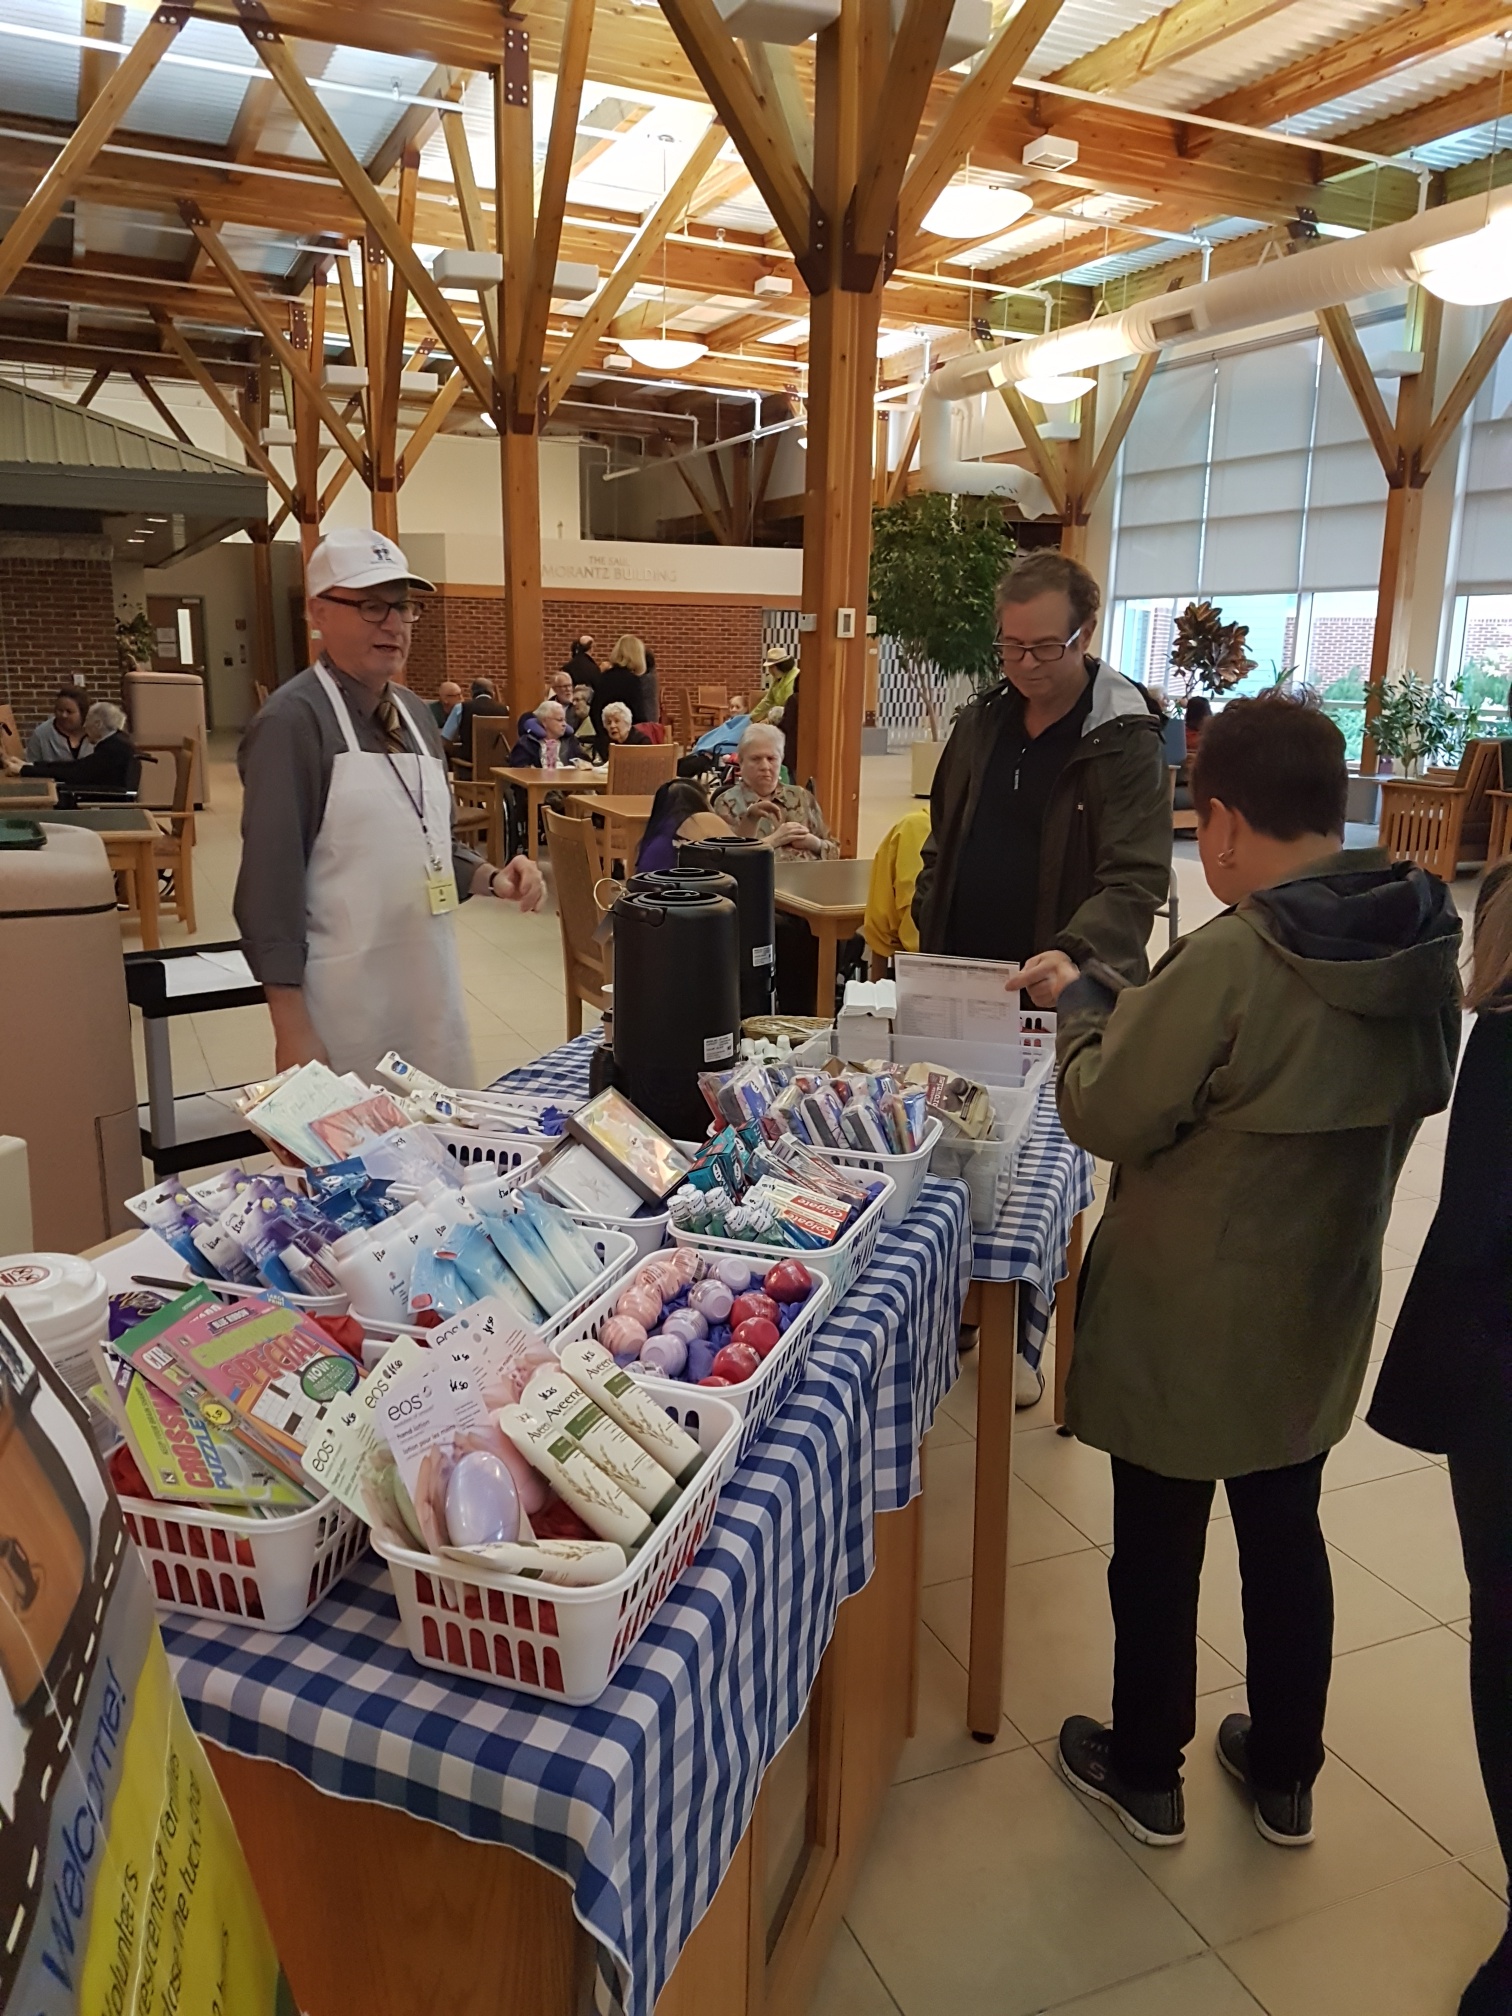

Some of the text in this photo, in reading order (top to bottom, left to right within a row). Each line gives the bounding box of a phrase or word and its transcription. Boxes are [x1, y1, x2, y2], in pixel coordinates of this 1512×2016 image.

[542, 564, 677, 582] MORANTZ BUILDING
[589, 556, 606, 565] THE
[797, 1197, 844, 1219] Colgate
[788, 1211, 833, 1237] Colgate
[220, 1329, 322, 1390] SPECIAL
[306, 1361, 335, 1383] NOW!
[364, 1378, 390, 1410] eos
[387, 1393, 424, 1422] eos
[312, 1440, 335, 1473] eos
[41, 1656, 126, 1993] Welcome!
